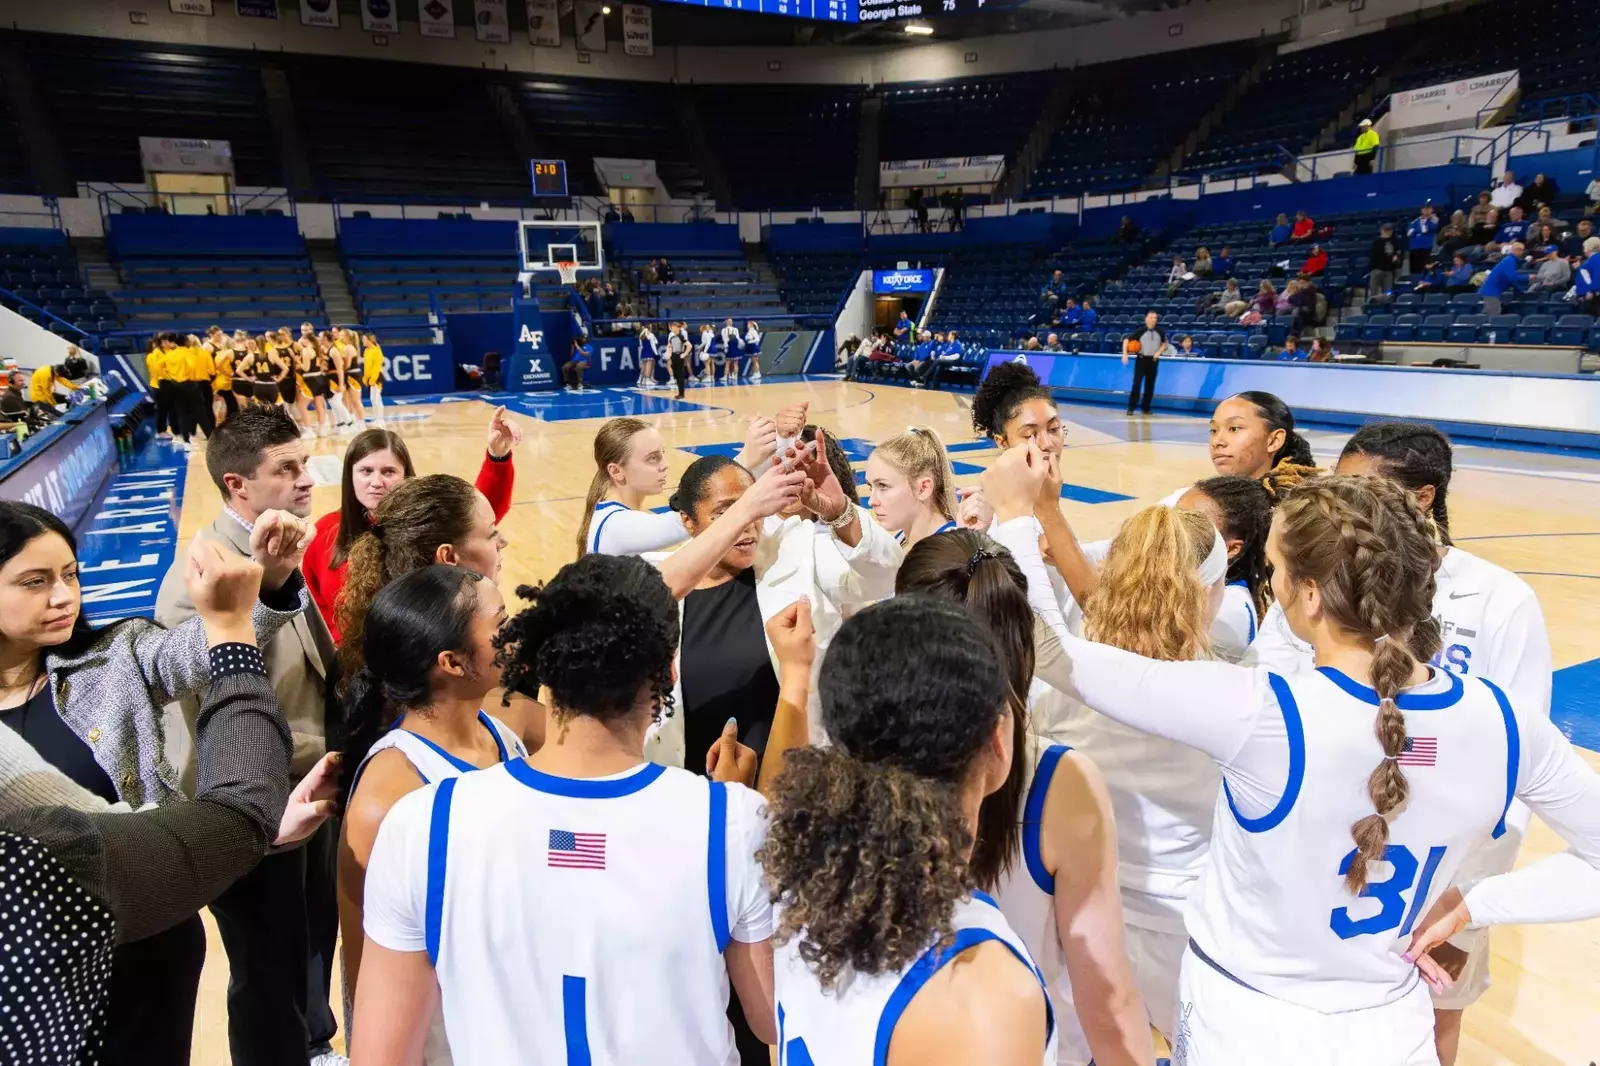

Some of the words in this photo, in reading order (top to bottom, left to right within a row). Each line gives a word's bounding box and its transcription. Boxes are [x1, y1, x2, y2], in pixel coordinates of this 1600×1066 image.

[859, 8, 896, 21] Georgia
[898, 4, 922, 17] State
[518, 324, 544, 350] AF
[84, 468, 178, 535] ARENA
[1329, 844, 1448, 941] 31
